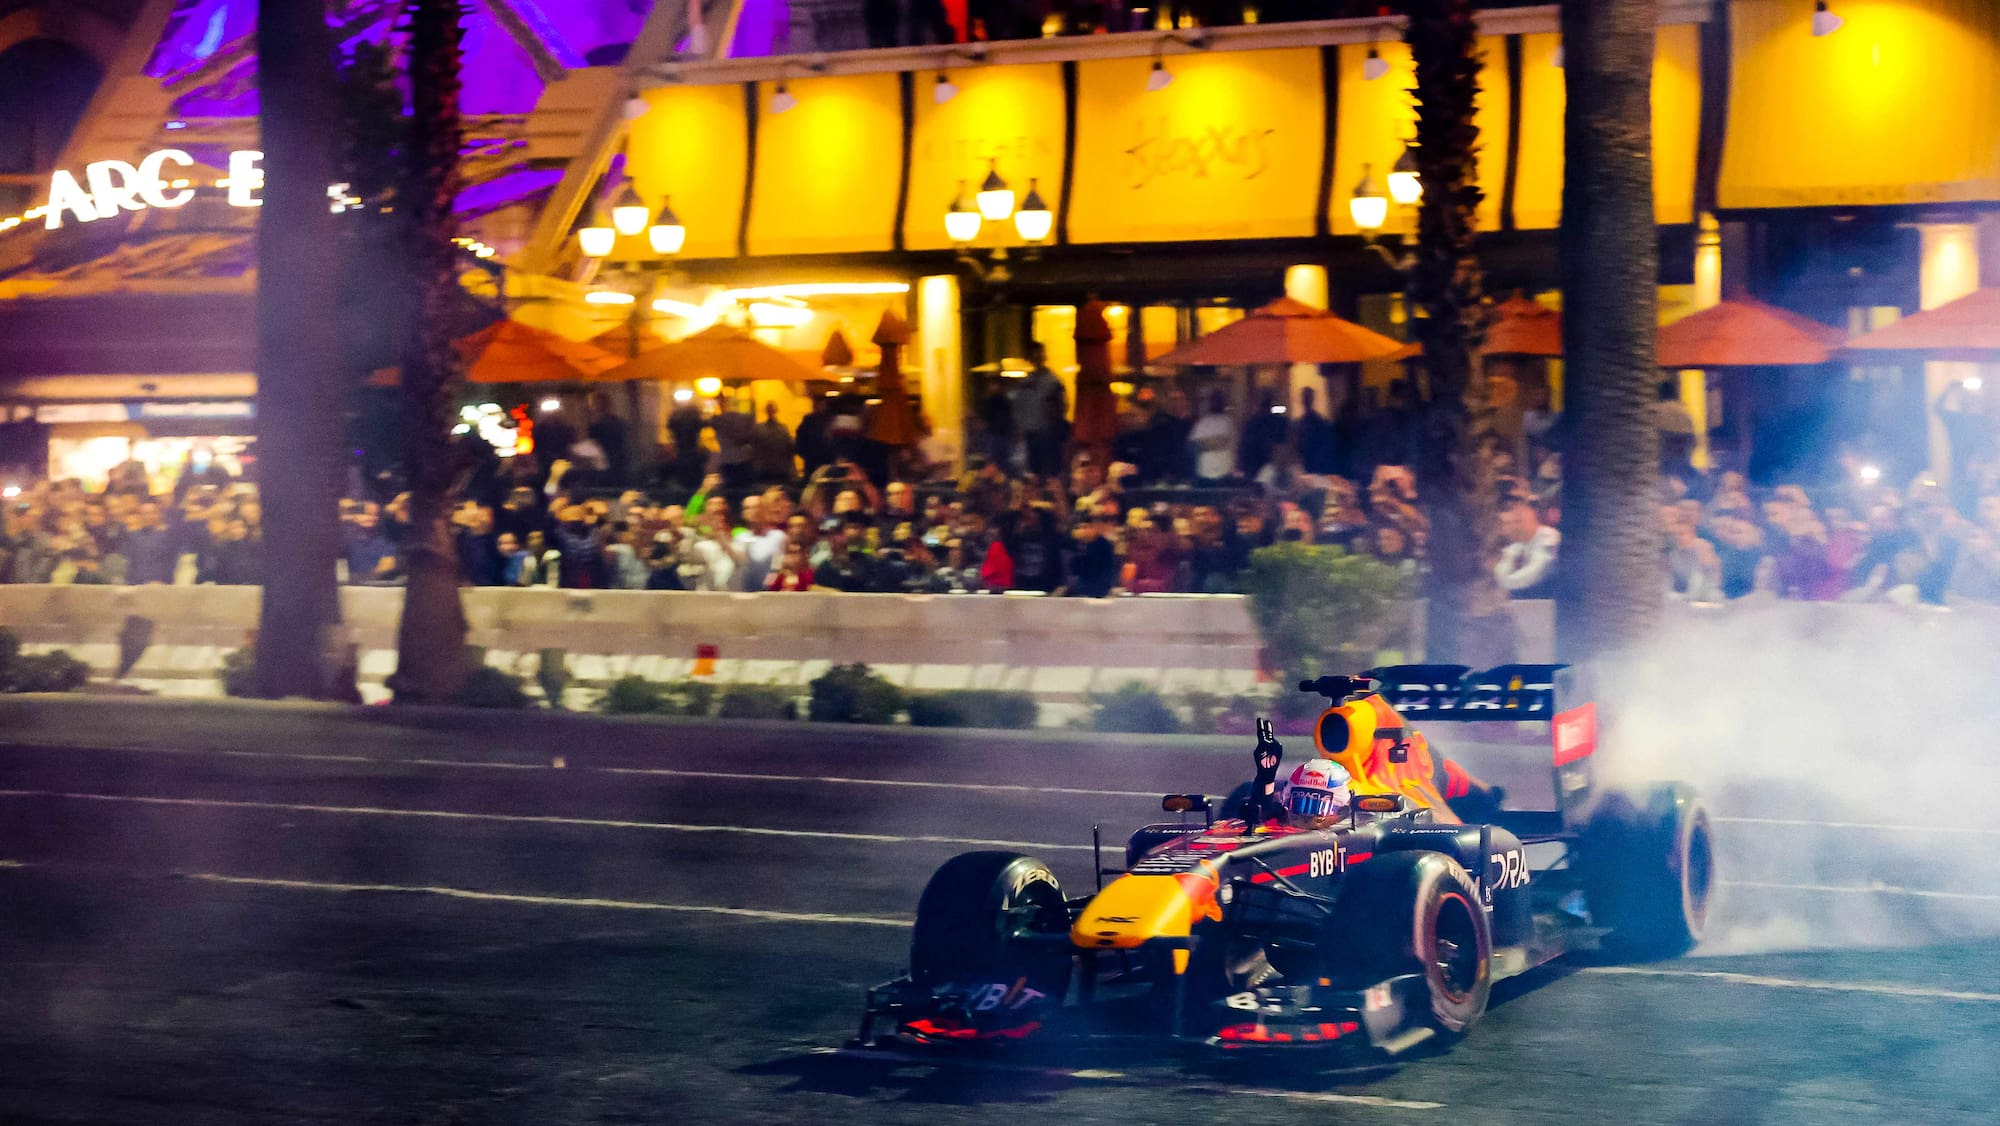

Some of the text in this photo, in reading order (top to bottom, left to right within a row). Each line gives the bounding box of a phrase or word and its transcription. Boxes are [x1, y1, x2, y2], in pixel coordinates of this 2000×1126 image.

[44, 149, 196, 231] ARC
[1310, 840, 1347, 879] BYBIT
[1012, 868, 1060, 899] ZERO
